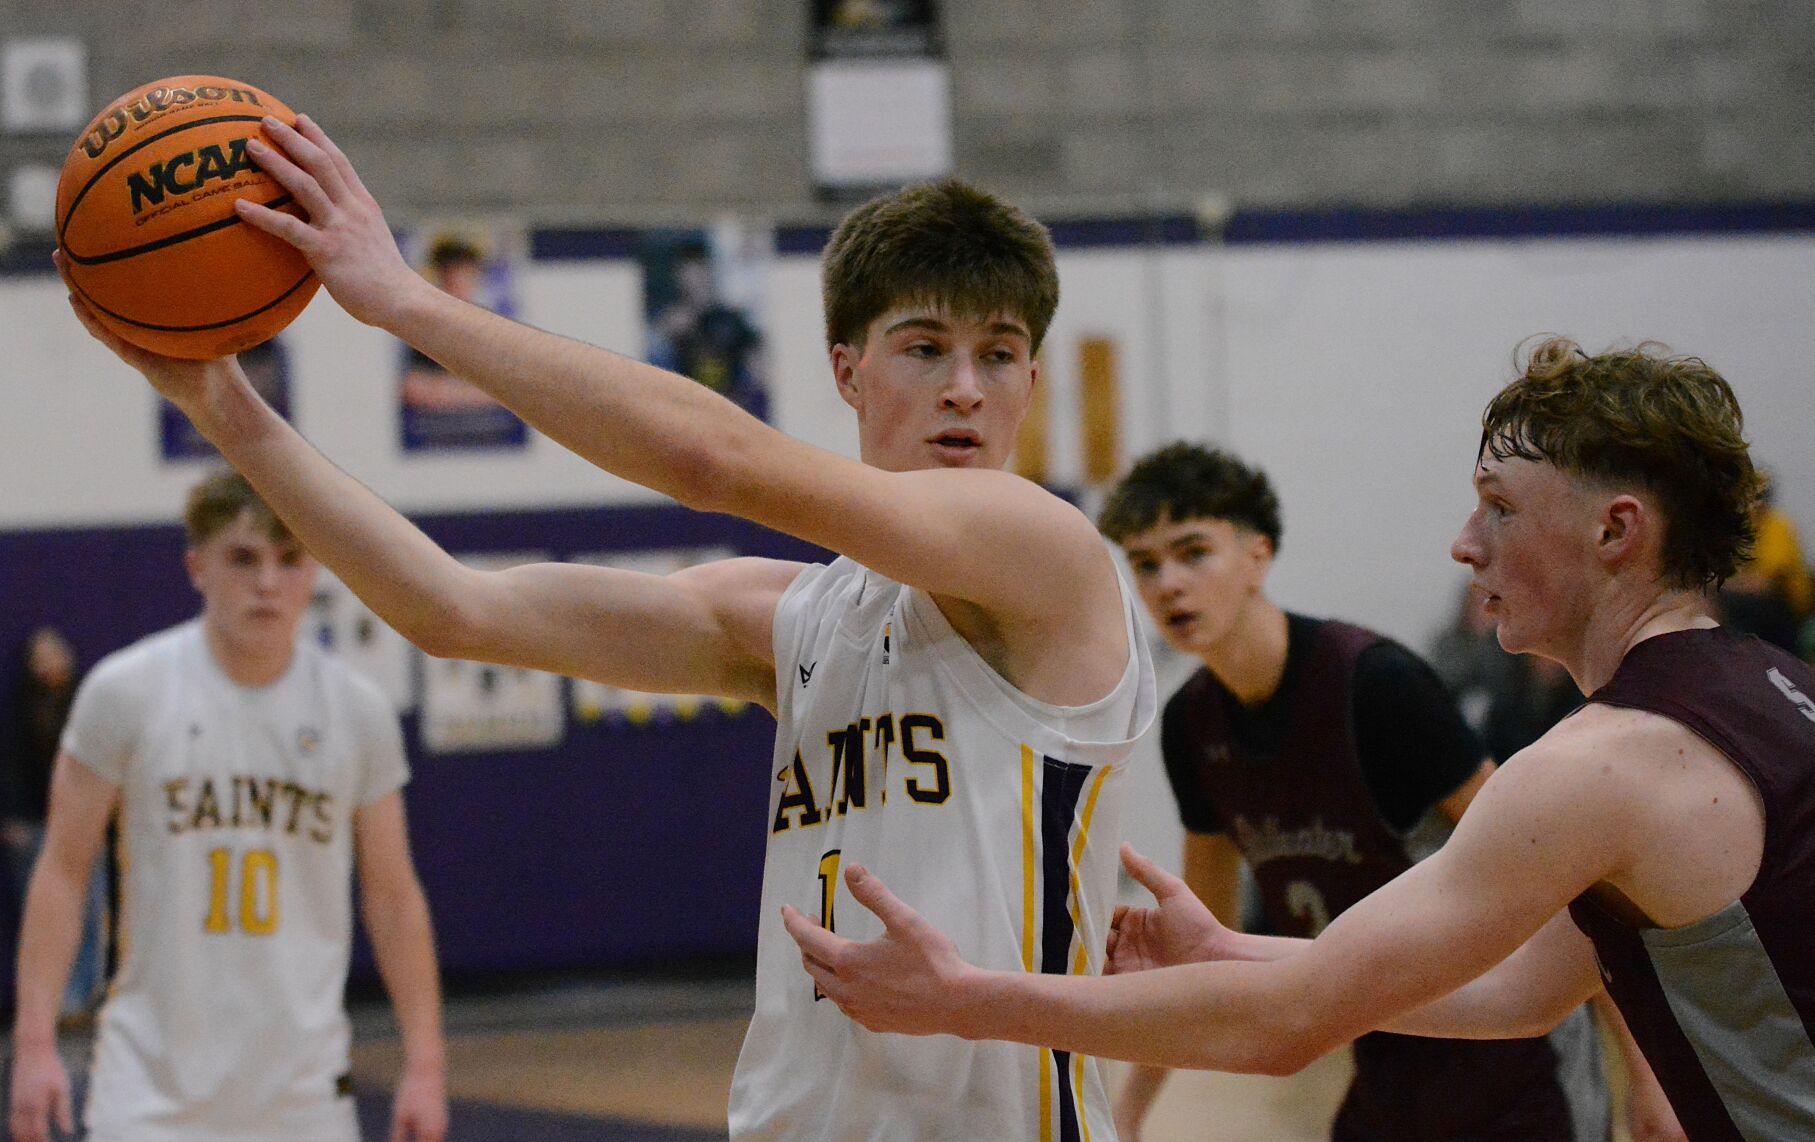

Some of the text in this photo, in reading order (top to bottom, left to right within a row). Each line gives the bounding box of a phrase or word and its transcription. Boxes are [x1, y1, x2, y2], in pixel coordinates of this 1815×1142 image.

[79, 86, 263, 159] Wilson
[126, 137, 263, 215] NCAA
[161, 774, 333, 844] SAINTS
[203, 847, 278, 934] 10
